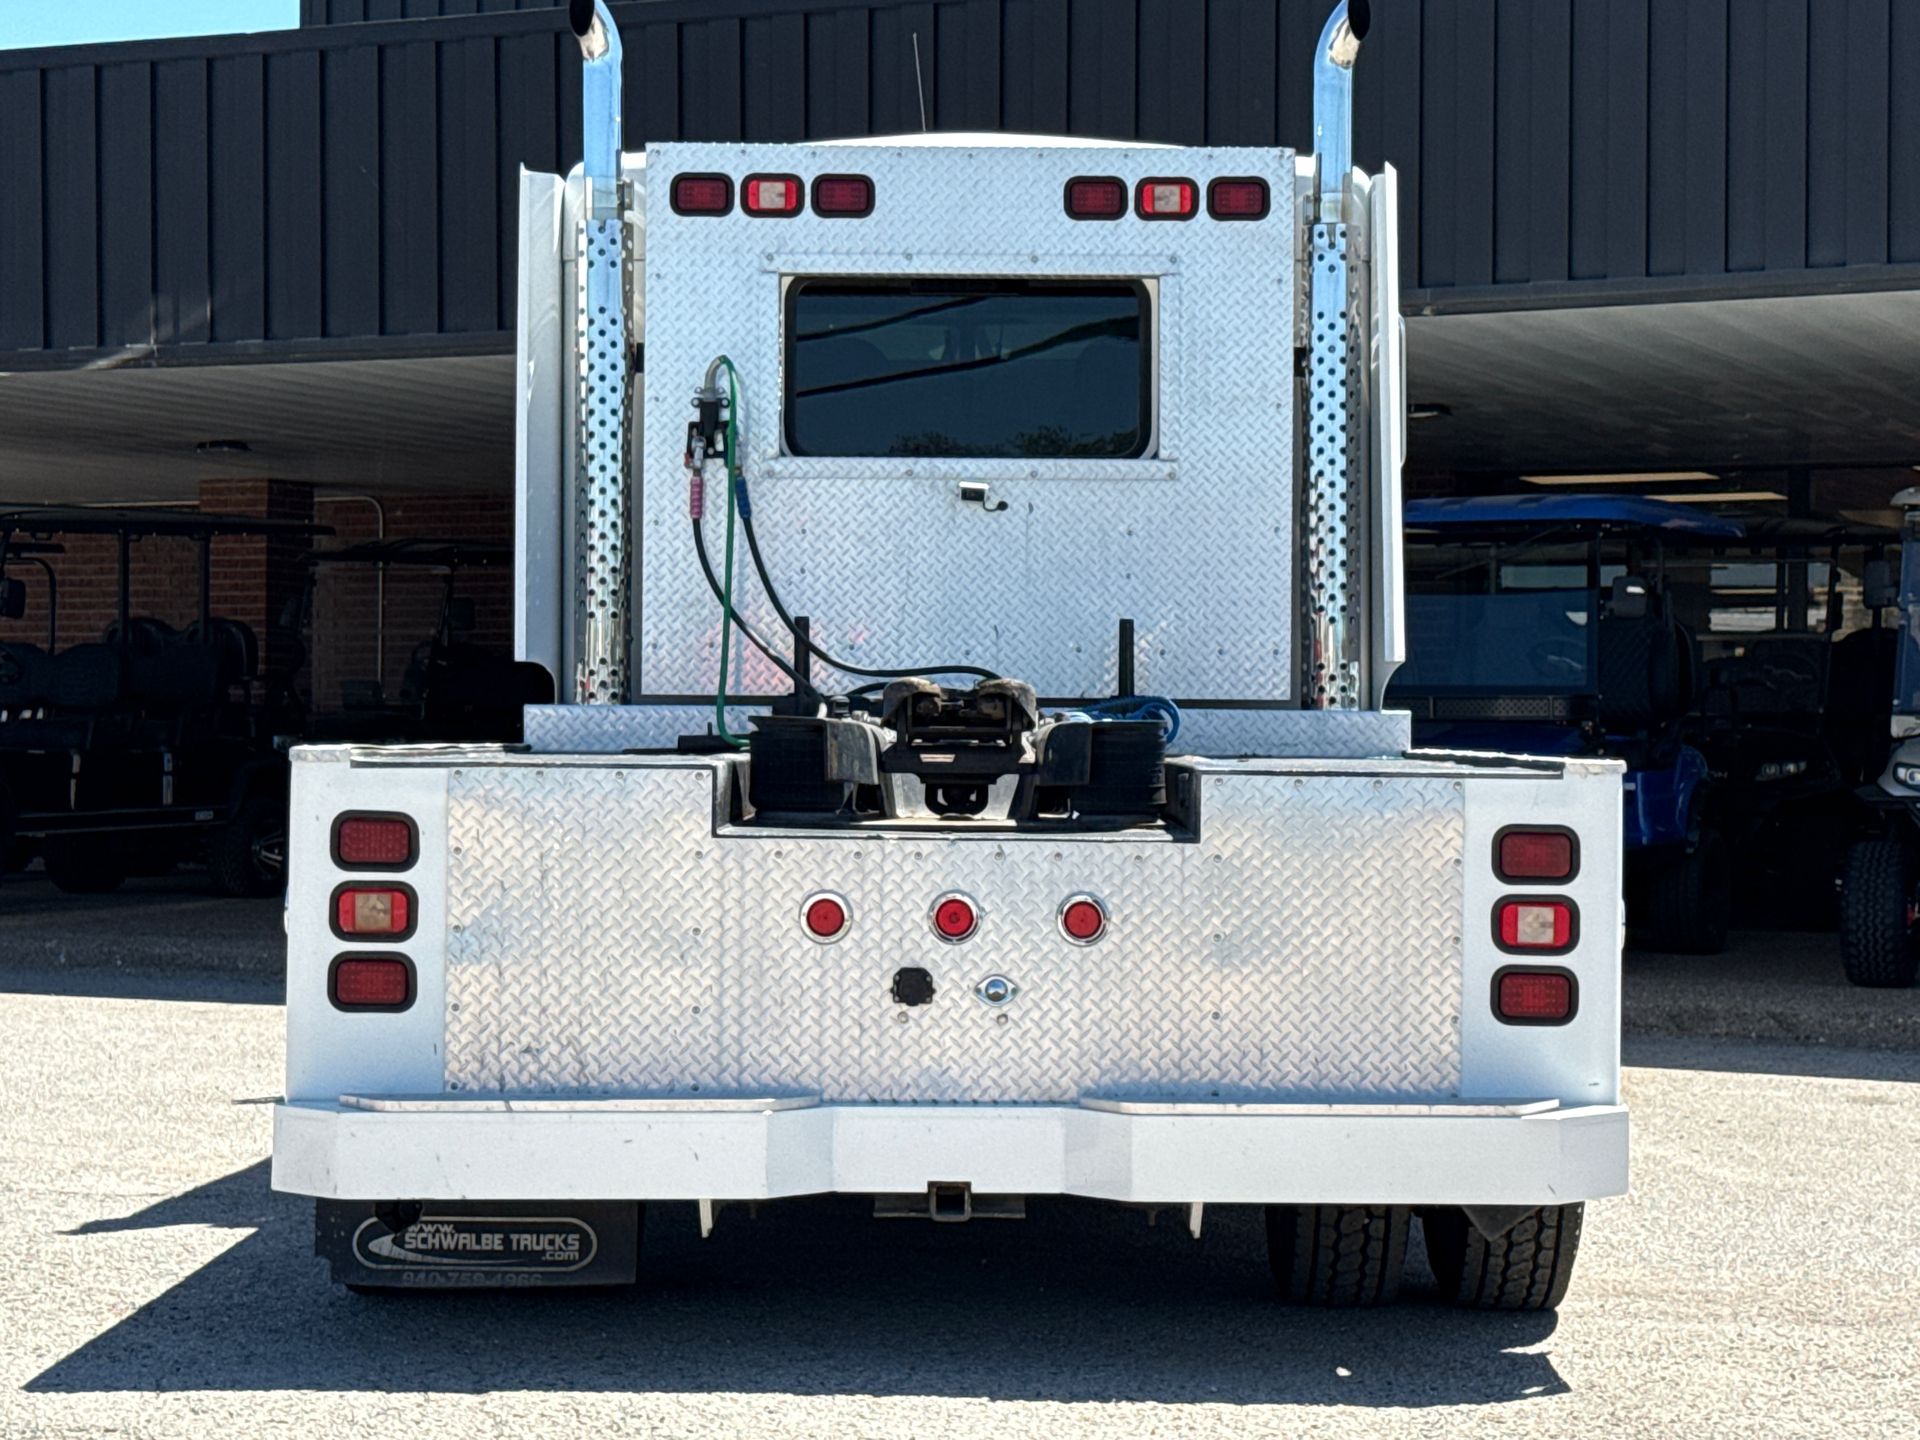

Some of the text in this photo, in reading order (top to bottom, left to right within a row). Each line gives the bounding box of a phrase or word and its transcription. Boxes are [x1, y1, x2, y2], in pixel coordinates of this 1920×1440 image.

[404, 1232, 580, 1251] SCHWALBE TRUCKS
[541, 1251, 579, 1261] .com
